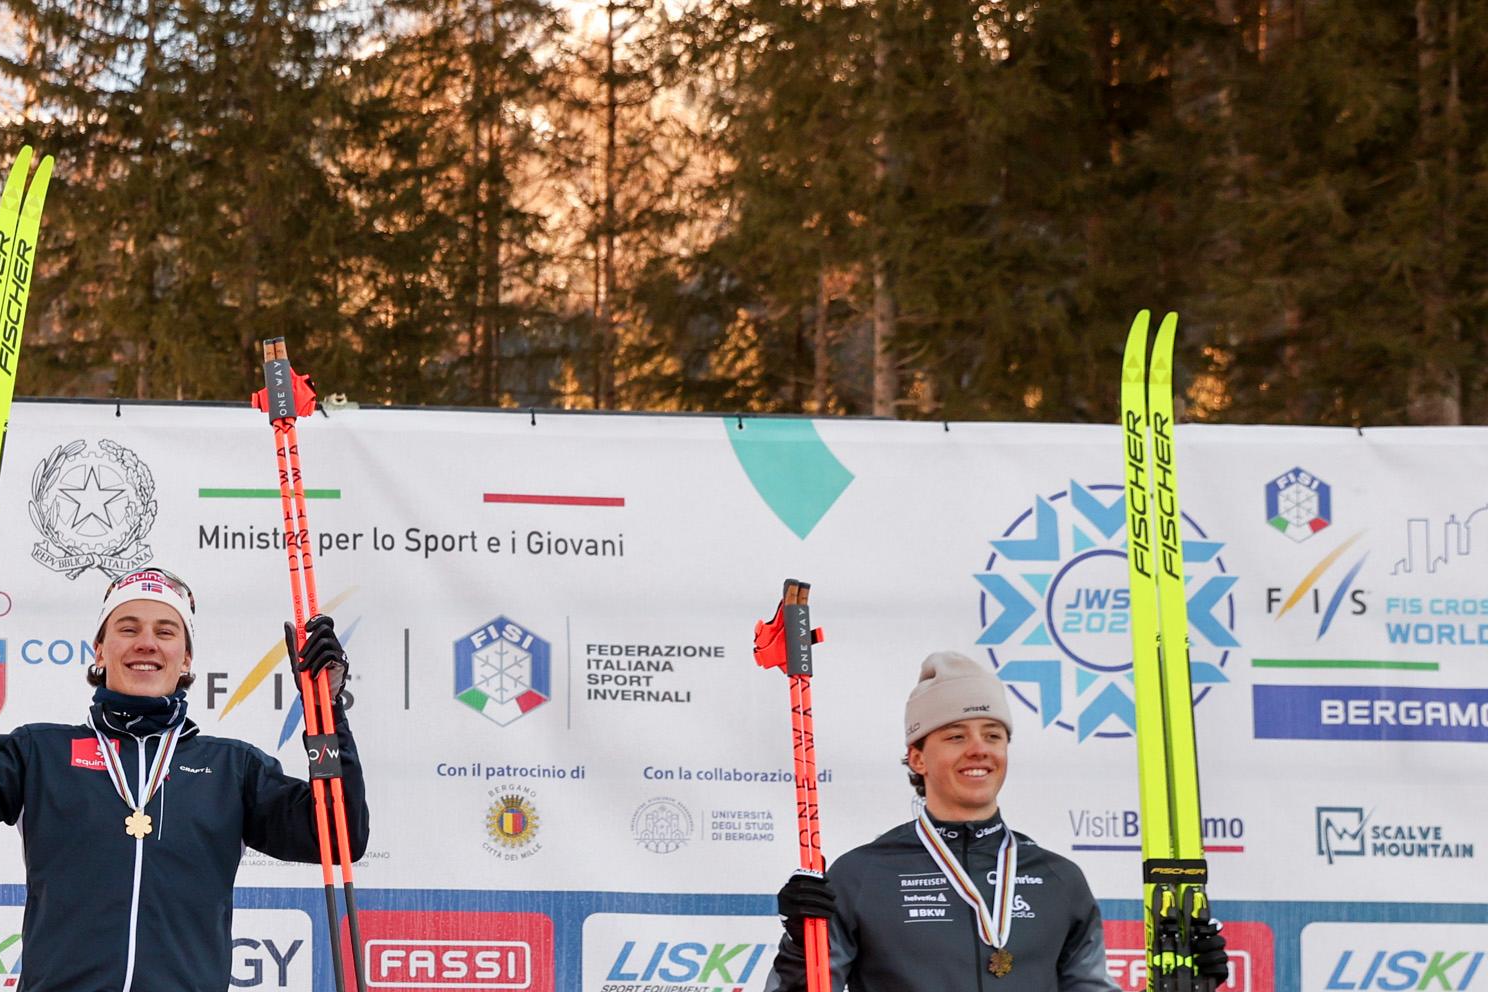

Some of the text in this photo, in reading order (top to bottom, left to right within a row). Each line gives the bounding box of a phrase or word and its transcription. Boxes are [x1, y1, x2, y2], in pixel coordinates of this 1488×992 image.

[1277, 473, 1320, 490] FISI
[1127, 410, 1151, 578] FISCHER
[1154, 412, 1179, 580] FISCHER
[319, 527, 624, 558] per lo Sport e i Giovani
[1065, 588, 1130, 610] JWS
[1386, 597, 1422, 615] FIS
[1062, 612, 1129, 633] 202
[470, 623, 534, 652] FISI
[21, 639, 96, 665] CON
[586, 643, 726, 659] FEDERAZIONE
[586, 659, 674, 673] ITALIANA
[586, 673, 653, 687] SPORT
[586, 688, 692, 704] INVERNALI
[436, 763, 586, 782] Con il patrocinio di
[643, 767, 833, 784] Con la collaborazio di
[712, 822, 774, 832] DEGLI STUDI
[1372, 826, 1443, 841] SCALVE
[712, 832, 722, 841] DI
[1372, 843, 1474, 858] MOUNTAIN
[900, 877, 947, 887] RAIFFEISEN
[919, 908, 945, 917] BKW
[230, 938, 304, 988] GY
[606, 941, 767, 984] LISKI
[1326, 950, 1486, 991] LISKI
